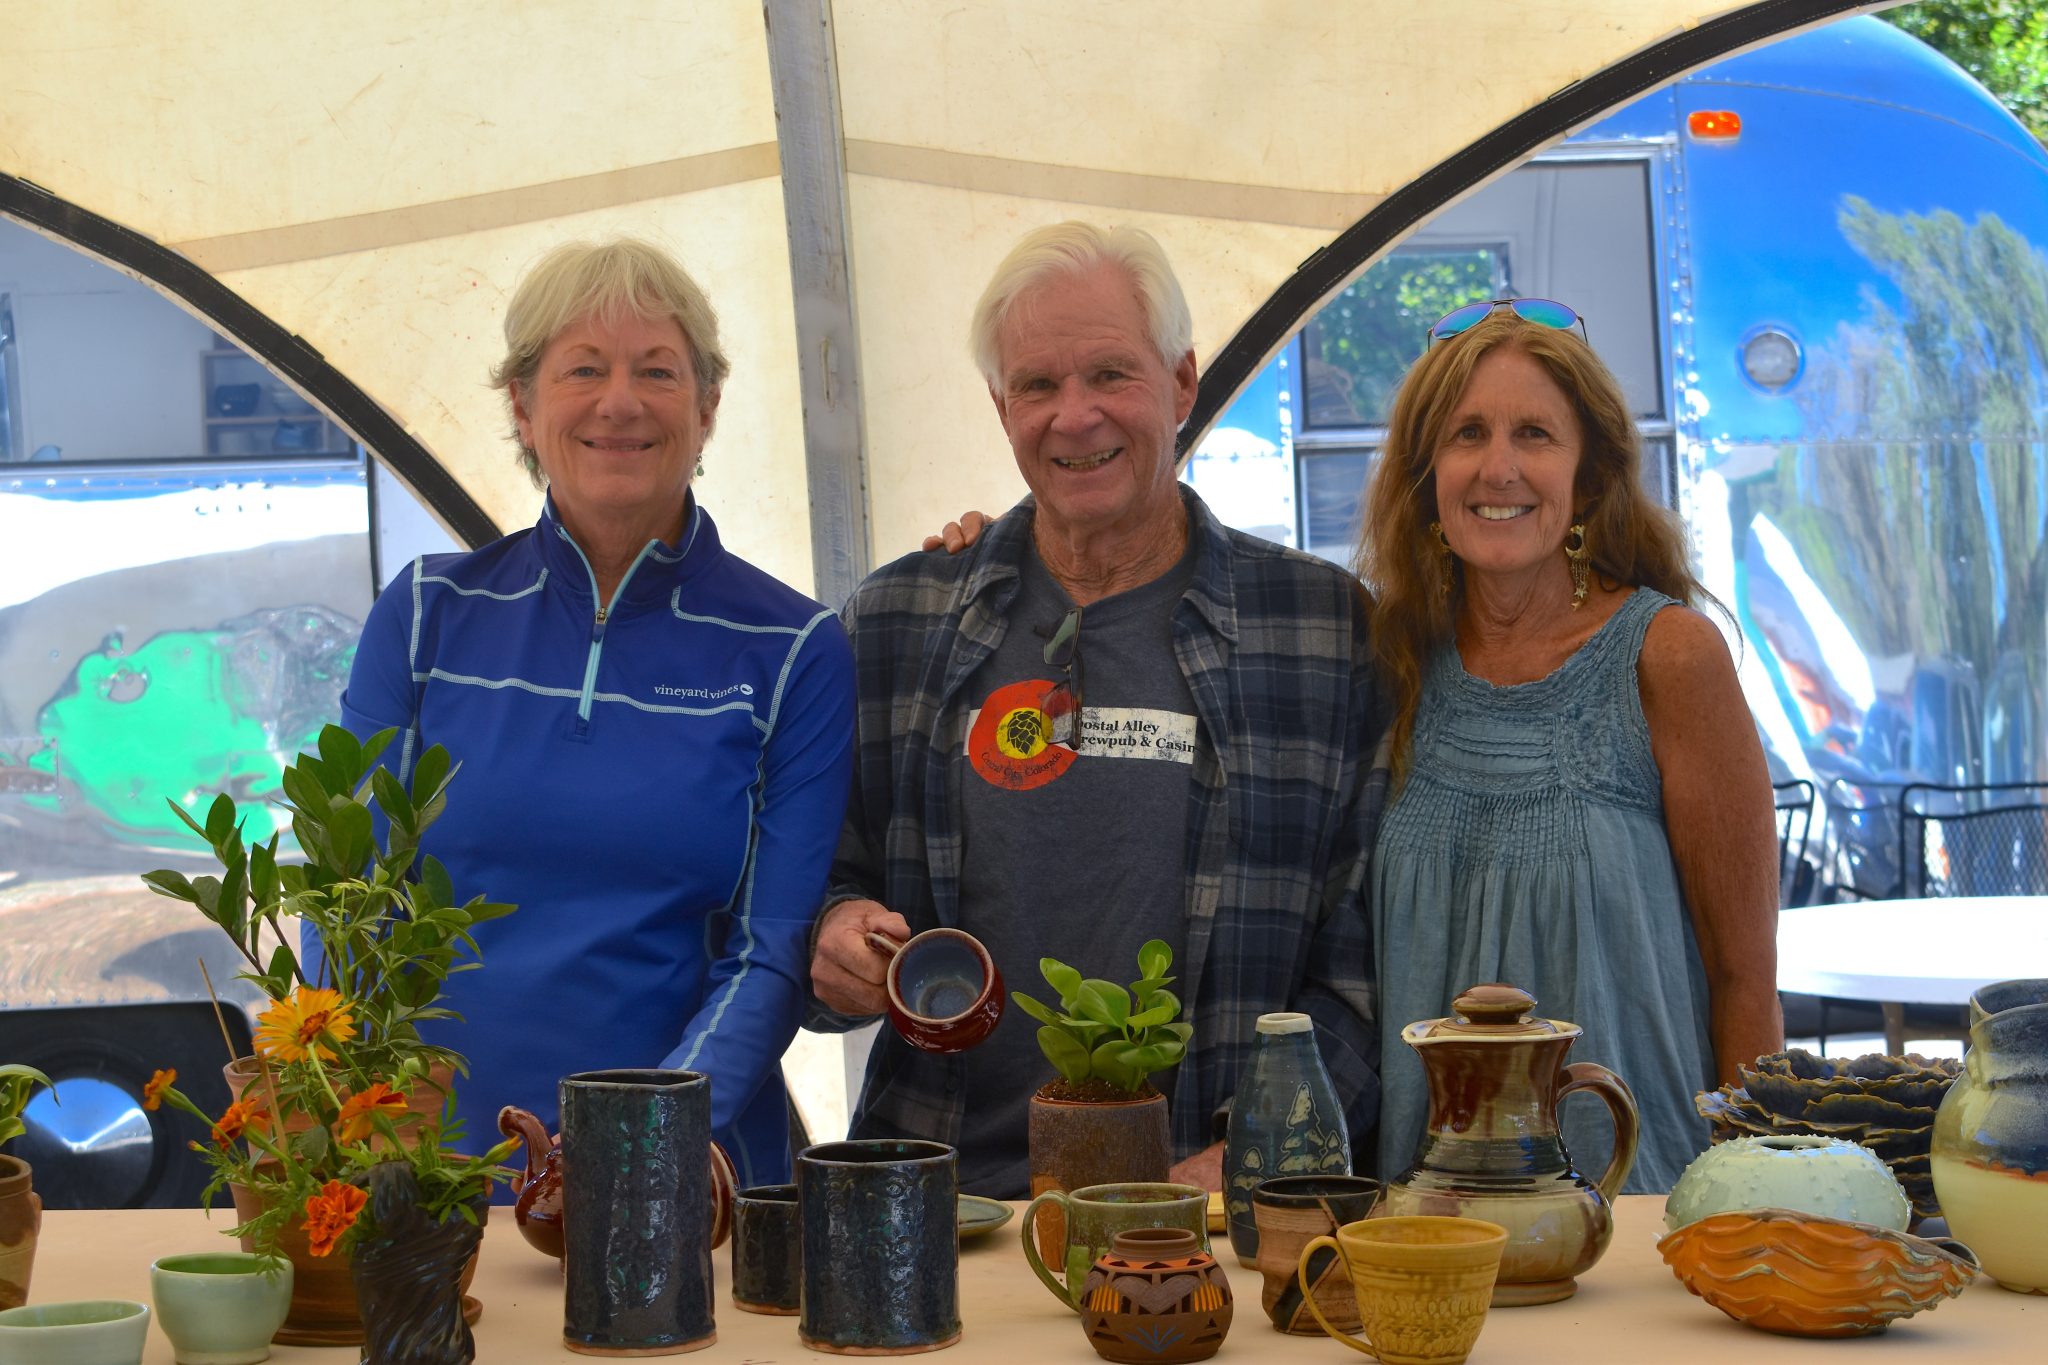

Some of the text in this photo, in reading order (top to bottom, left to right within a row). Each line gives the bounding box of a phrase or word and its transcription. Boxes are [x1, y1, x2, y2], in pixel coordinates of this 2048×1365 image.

[654, 684, 739, 700] vineyard vines
[1080, 720, 1161, 735] ostal Alley
[1080, 735, 1195, 753] rewpub & Casin
